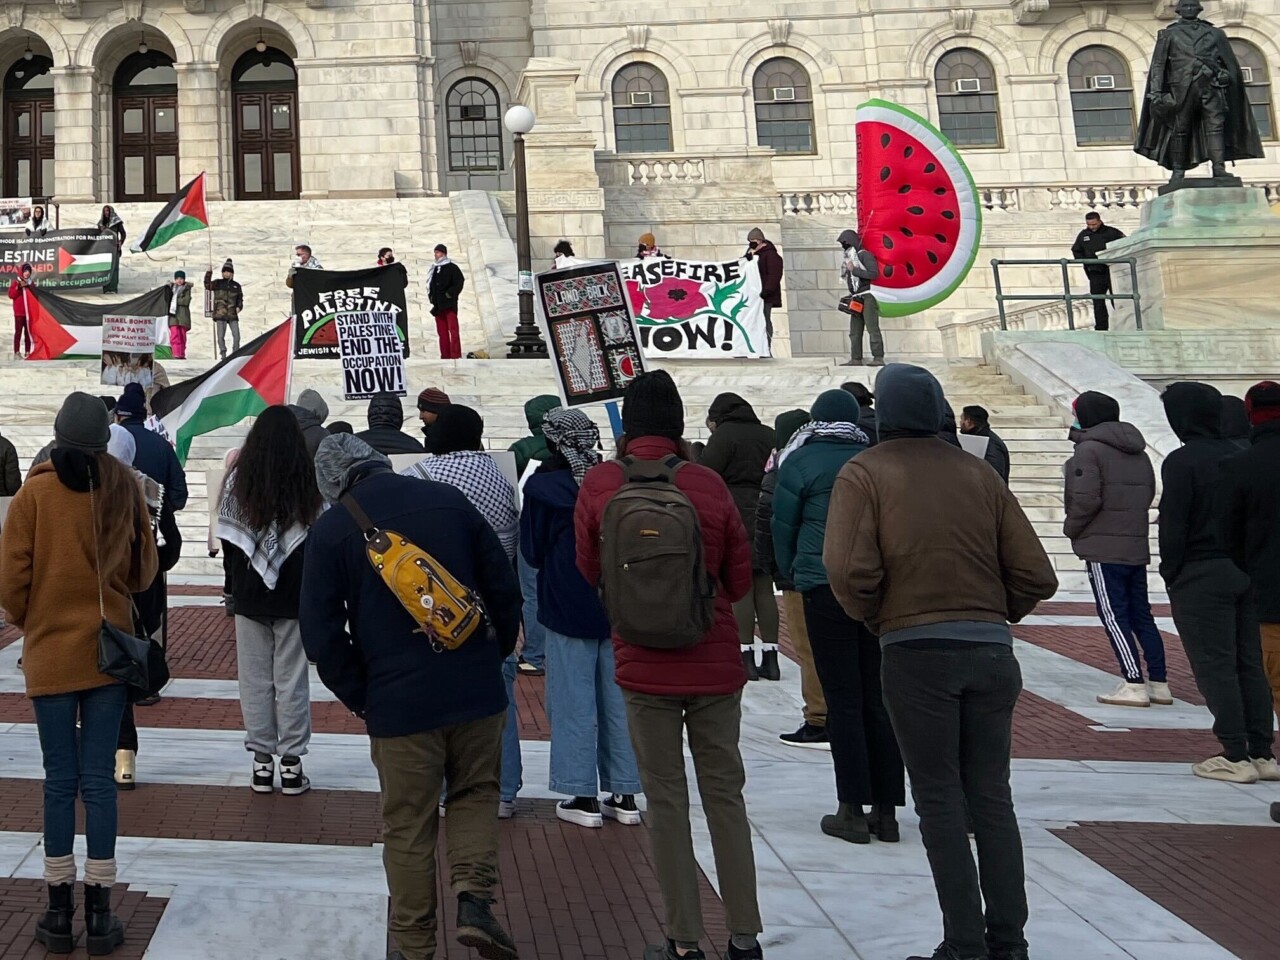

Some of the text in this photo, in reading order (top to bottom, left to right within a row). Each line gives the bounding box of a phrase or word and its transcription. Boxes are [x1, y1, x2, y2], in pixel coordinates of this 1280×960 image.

[34, 235, 76, 243] DEMONSTRATION
[42, 278, 57, 287] the
[60, 273, 111, 287] occupation!
[622, 260, 741, 285] EASEFIRE
[318, 286, 380, 303] FREE
[554, 284, 610, 305] LAND BACK
[301, 297, 403, 330] PALESTINE
[336, 312, 393, 327] STAND WITH
[339, 324, 397, 339] PALESTINE!
[298, 346, 329, 355] JEWISH
[341, 337, 401, 357] END THE
[342, 354, 402, 369] OCCUPATION
[344, 366, 404, 394] NOW!
